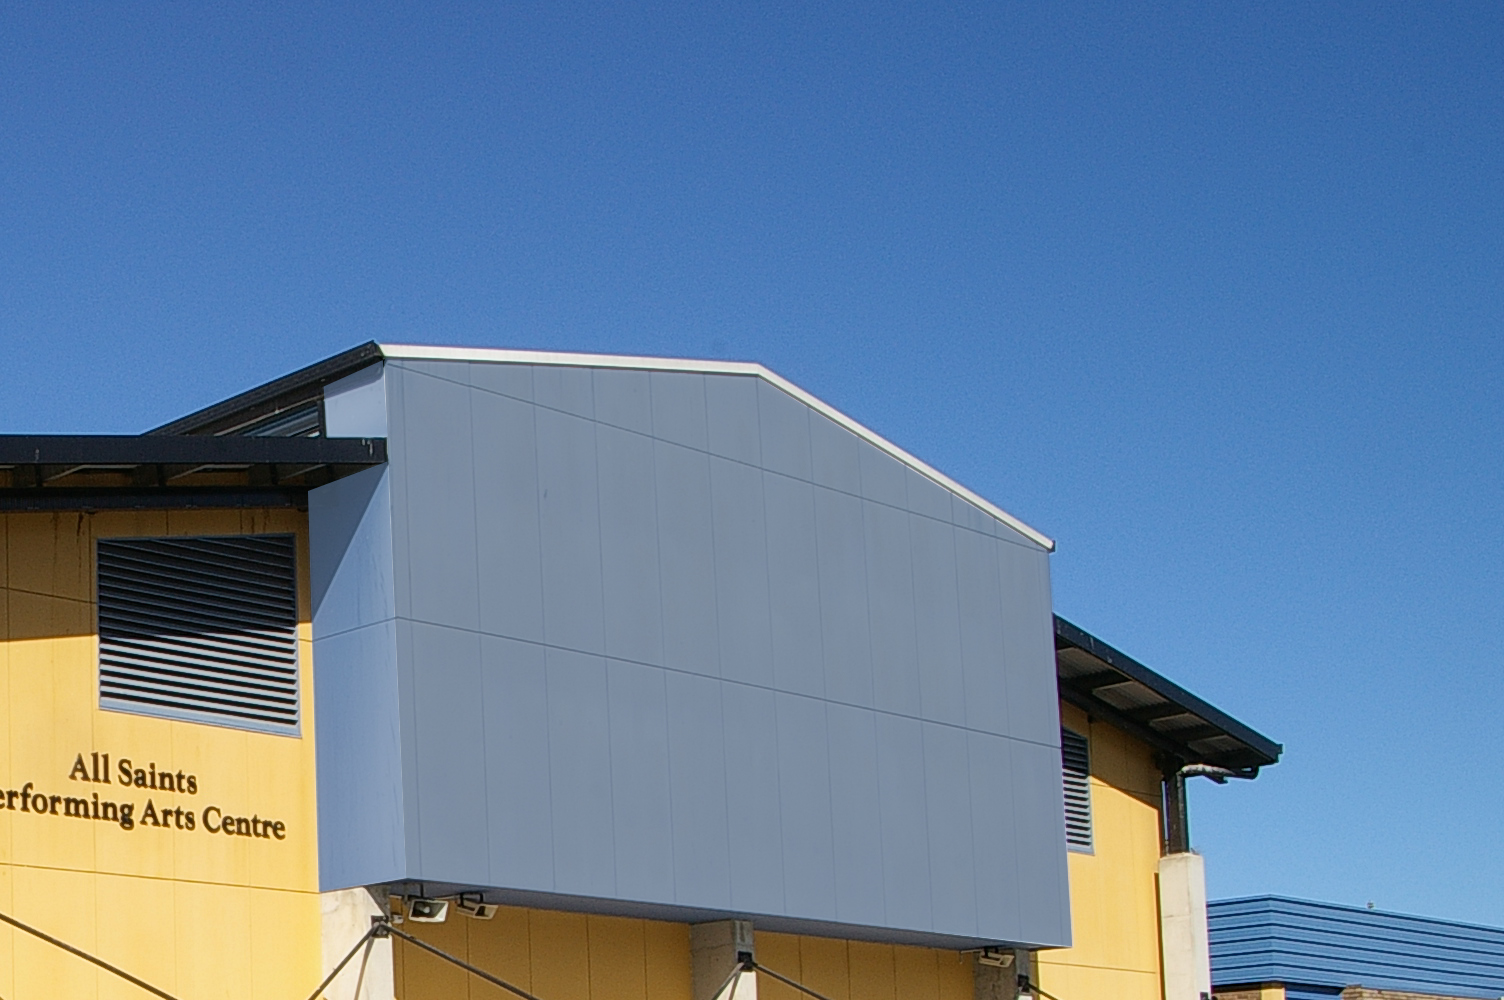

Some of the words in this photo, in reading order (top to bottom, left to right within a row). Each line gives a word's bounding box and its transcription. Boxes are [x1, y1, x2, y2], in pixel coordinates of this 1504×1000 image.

[69, 752, 111, 784] All
[118, 759, 198, 795] Saints
[139, 798, 196, 831] Arts
[202, 806, 287, 840] Centre
